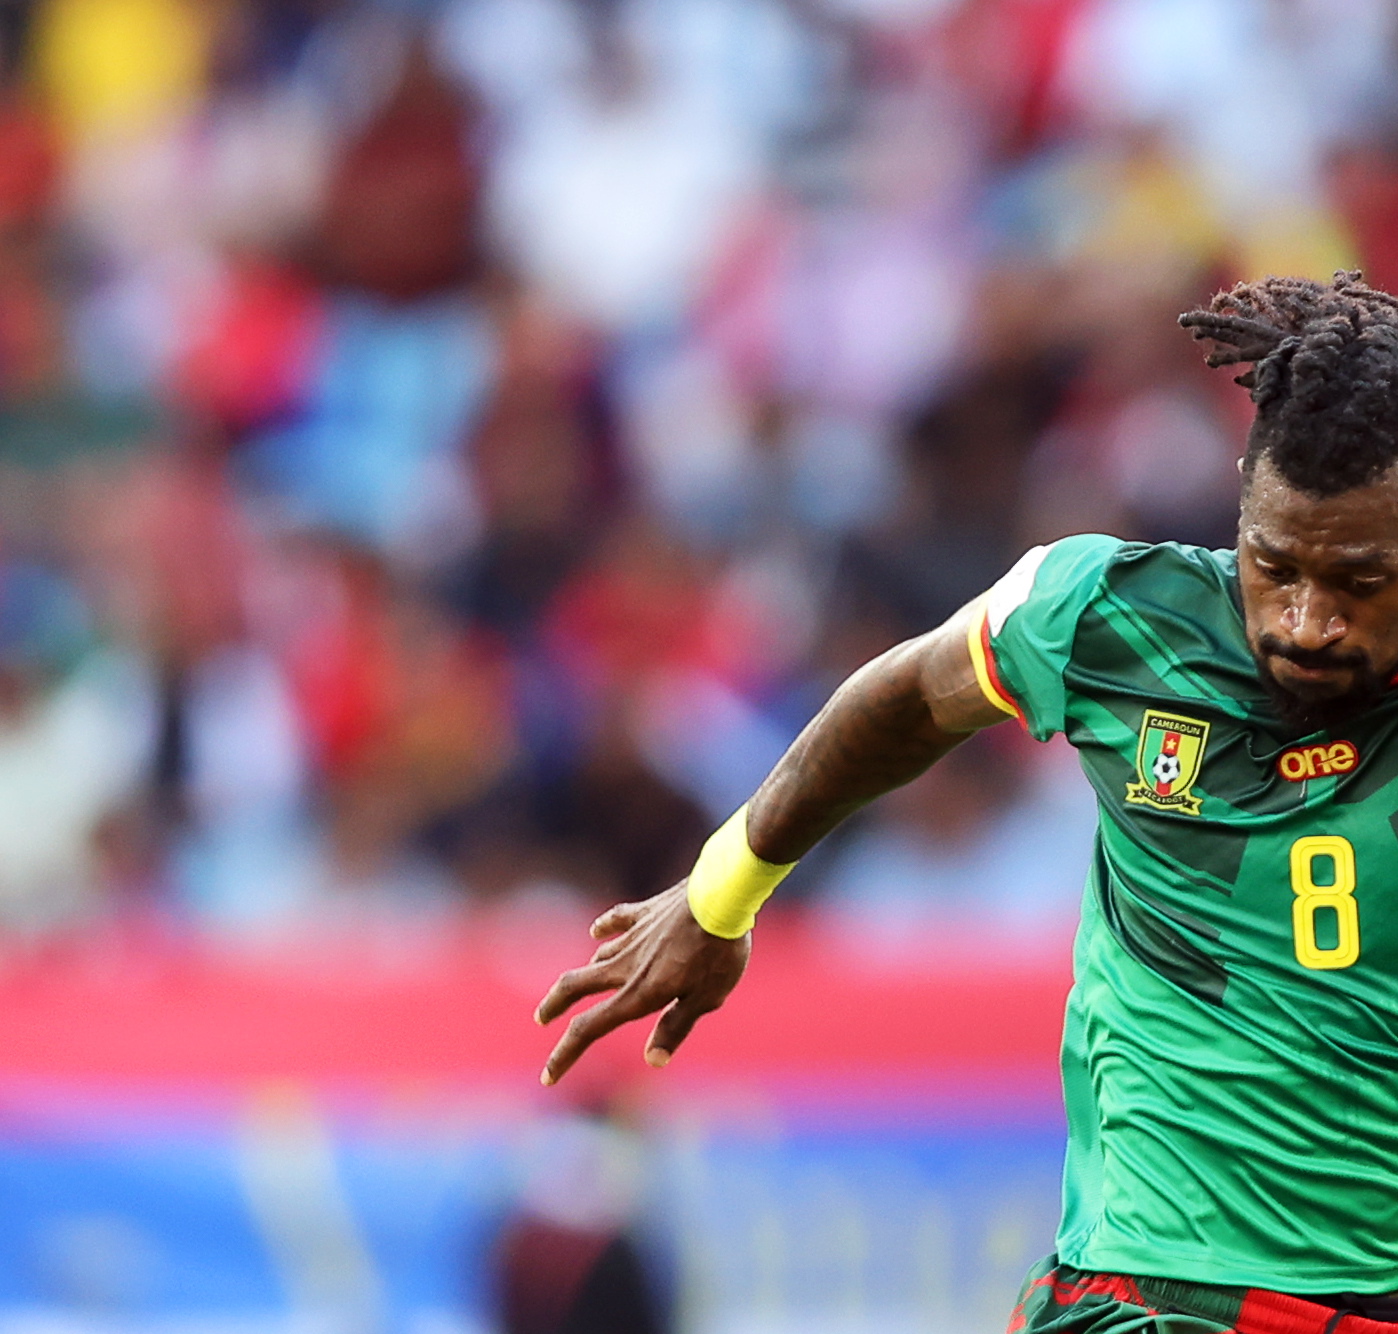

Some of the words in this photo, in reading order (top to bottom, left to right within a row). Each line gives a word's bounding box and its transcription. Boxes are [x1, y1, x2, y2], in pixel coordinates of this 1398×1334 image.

[1150, 717, 1202, 736] CAMEROUN
[1280, 743, 1355, 779] one
[1289, 834, 1361, 970] 8
